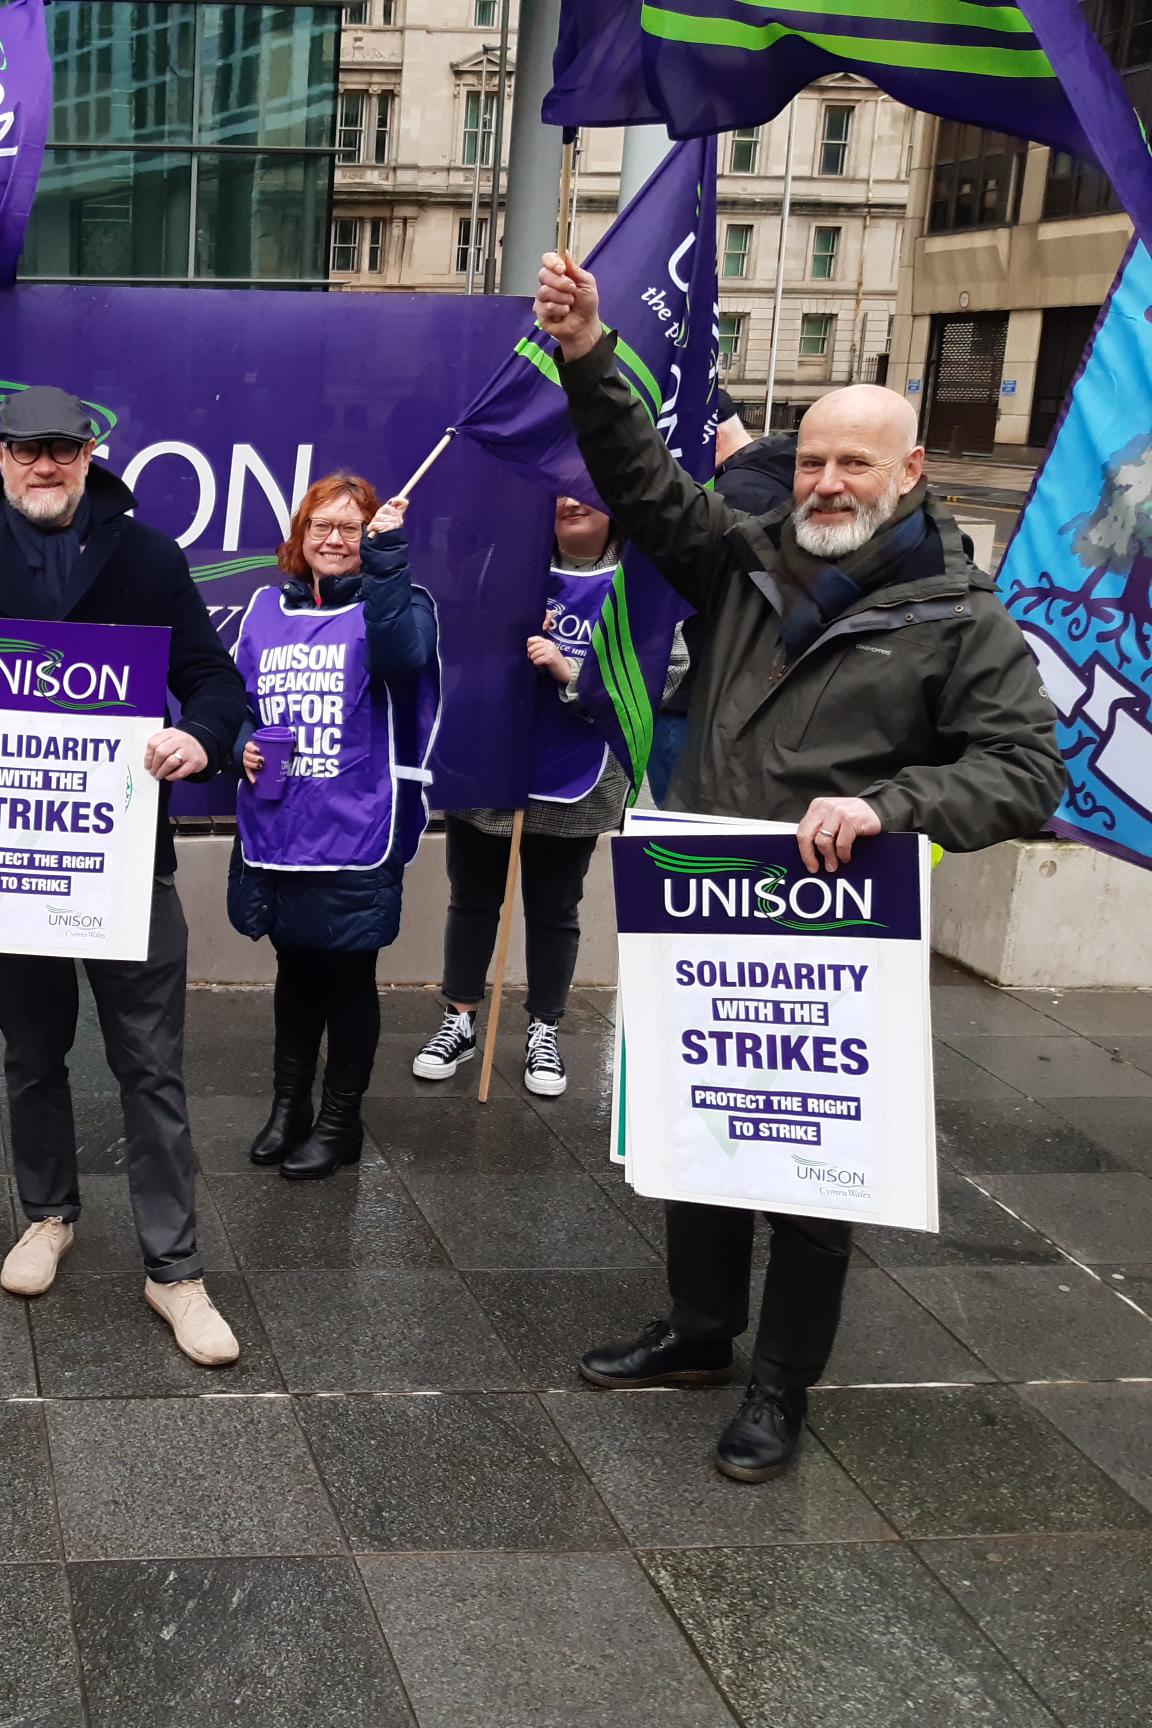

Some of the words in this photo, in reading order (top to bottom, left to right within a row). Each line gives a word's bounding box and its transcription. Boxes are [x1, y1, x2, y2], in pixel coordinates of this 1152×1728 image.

[641, 286, 672, 322] the
[259, 643, 346, 673] UNISON
[257, 671, 344, 695] SPEAKING
[258, 696, 286, 726] UP
[287, 693, 343, 725] FOR
[48, 771, 84, 790] THE
[33, 853, 58, 867] THE
[62, 855, 103, 870] RIGHT
[0, 875, 18, 890] TO
[21, 877, 69, 892] STRIKE
[664, 877, 873, 920] UNISON
[48, 914, 103, 928] UNISON
[675, 960, 869, 992] SOLIDARITY
[716, 1000, 774, 1021] WITH
[780, 1002, 825, 1023] THE
[681, 1029, 869, 1075] STRIKES
[694, 1090, 767, 1109] PROTECT
[770, 1096, 803, 1111] THE
[807, 1099, 858, 1116] RIGHT
[733, 1121, 754, 1136] TO
[759, 1123, 817, 1141] STRIKE
[797, 1165, 865, 1185] UNISON
[819, 1186, 847, 1198] Cymru
[848, 1188, 872, 1199] Wales
